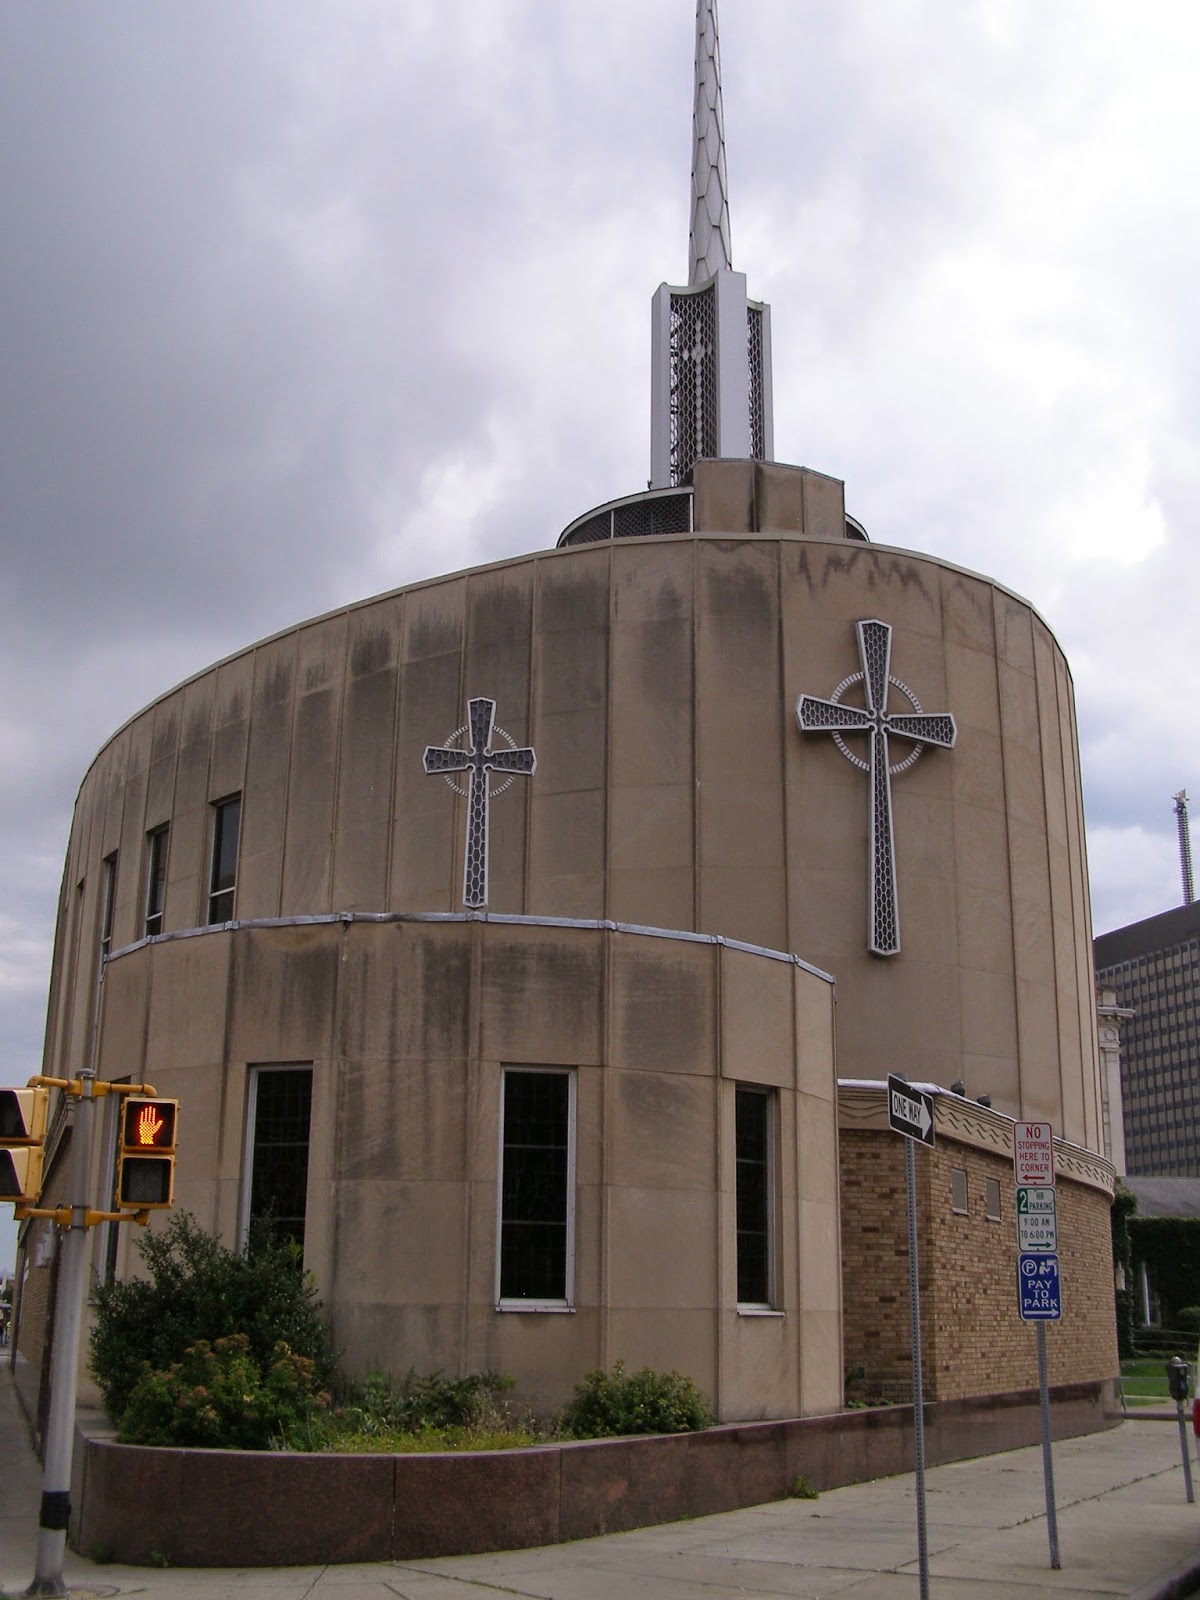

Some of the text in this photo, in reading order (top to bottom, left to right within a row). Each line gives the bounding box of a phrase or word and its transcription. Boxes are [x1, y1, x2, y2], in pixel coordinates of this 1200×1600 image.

[893, 1094, 921, 1124] ONE WAY
[1026, 1126, 1041, 1139] NO
[1018, 1141, 1050, 1150] STOPPING
[1020, 1152, 1050, 1161] HERE TO
[1020, 1163, 1049, 1172] CORNER
[1036, 1192, 1044, 1200] HR
[1020, 1191, 1027, 1211] 2
[1029, 1202, 1053, 1211] PARKING
[1024, 1218, 1050, 1227] 9:00 AM
[1030, 1230, 1044, 1239] 6:00
[1045, 1230, 1054, 1239] PM
[1026, 1262, 1034, 1273] P
[1028, 1280, 1052, 1289] PAY
[1033, 1290, 1049, 1299] TO
[1024, 1298, 1058, 1308] PARK
